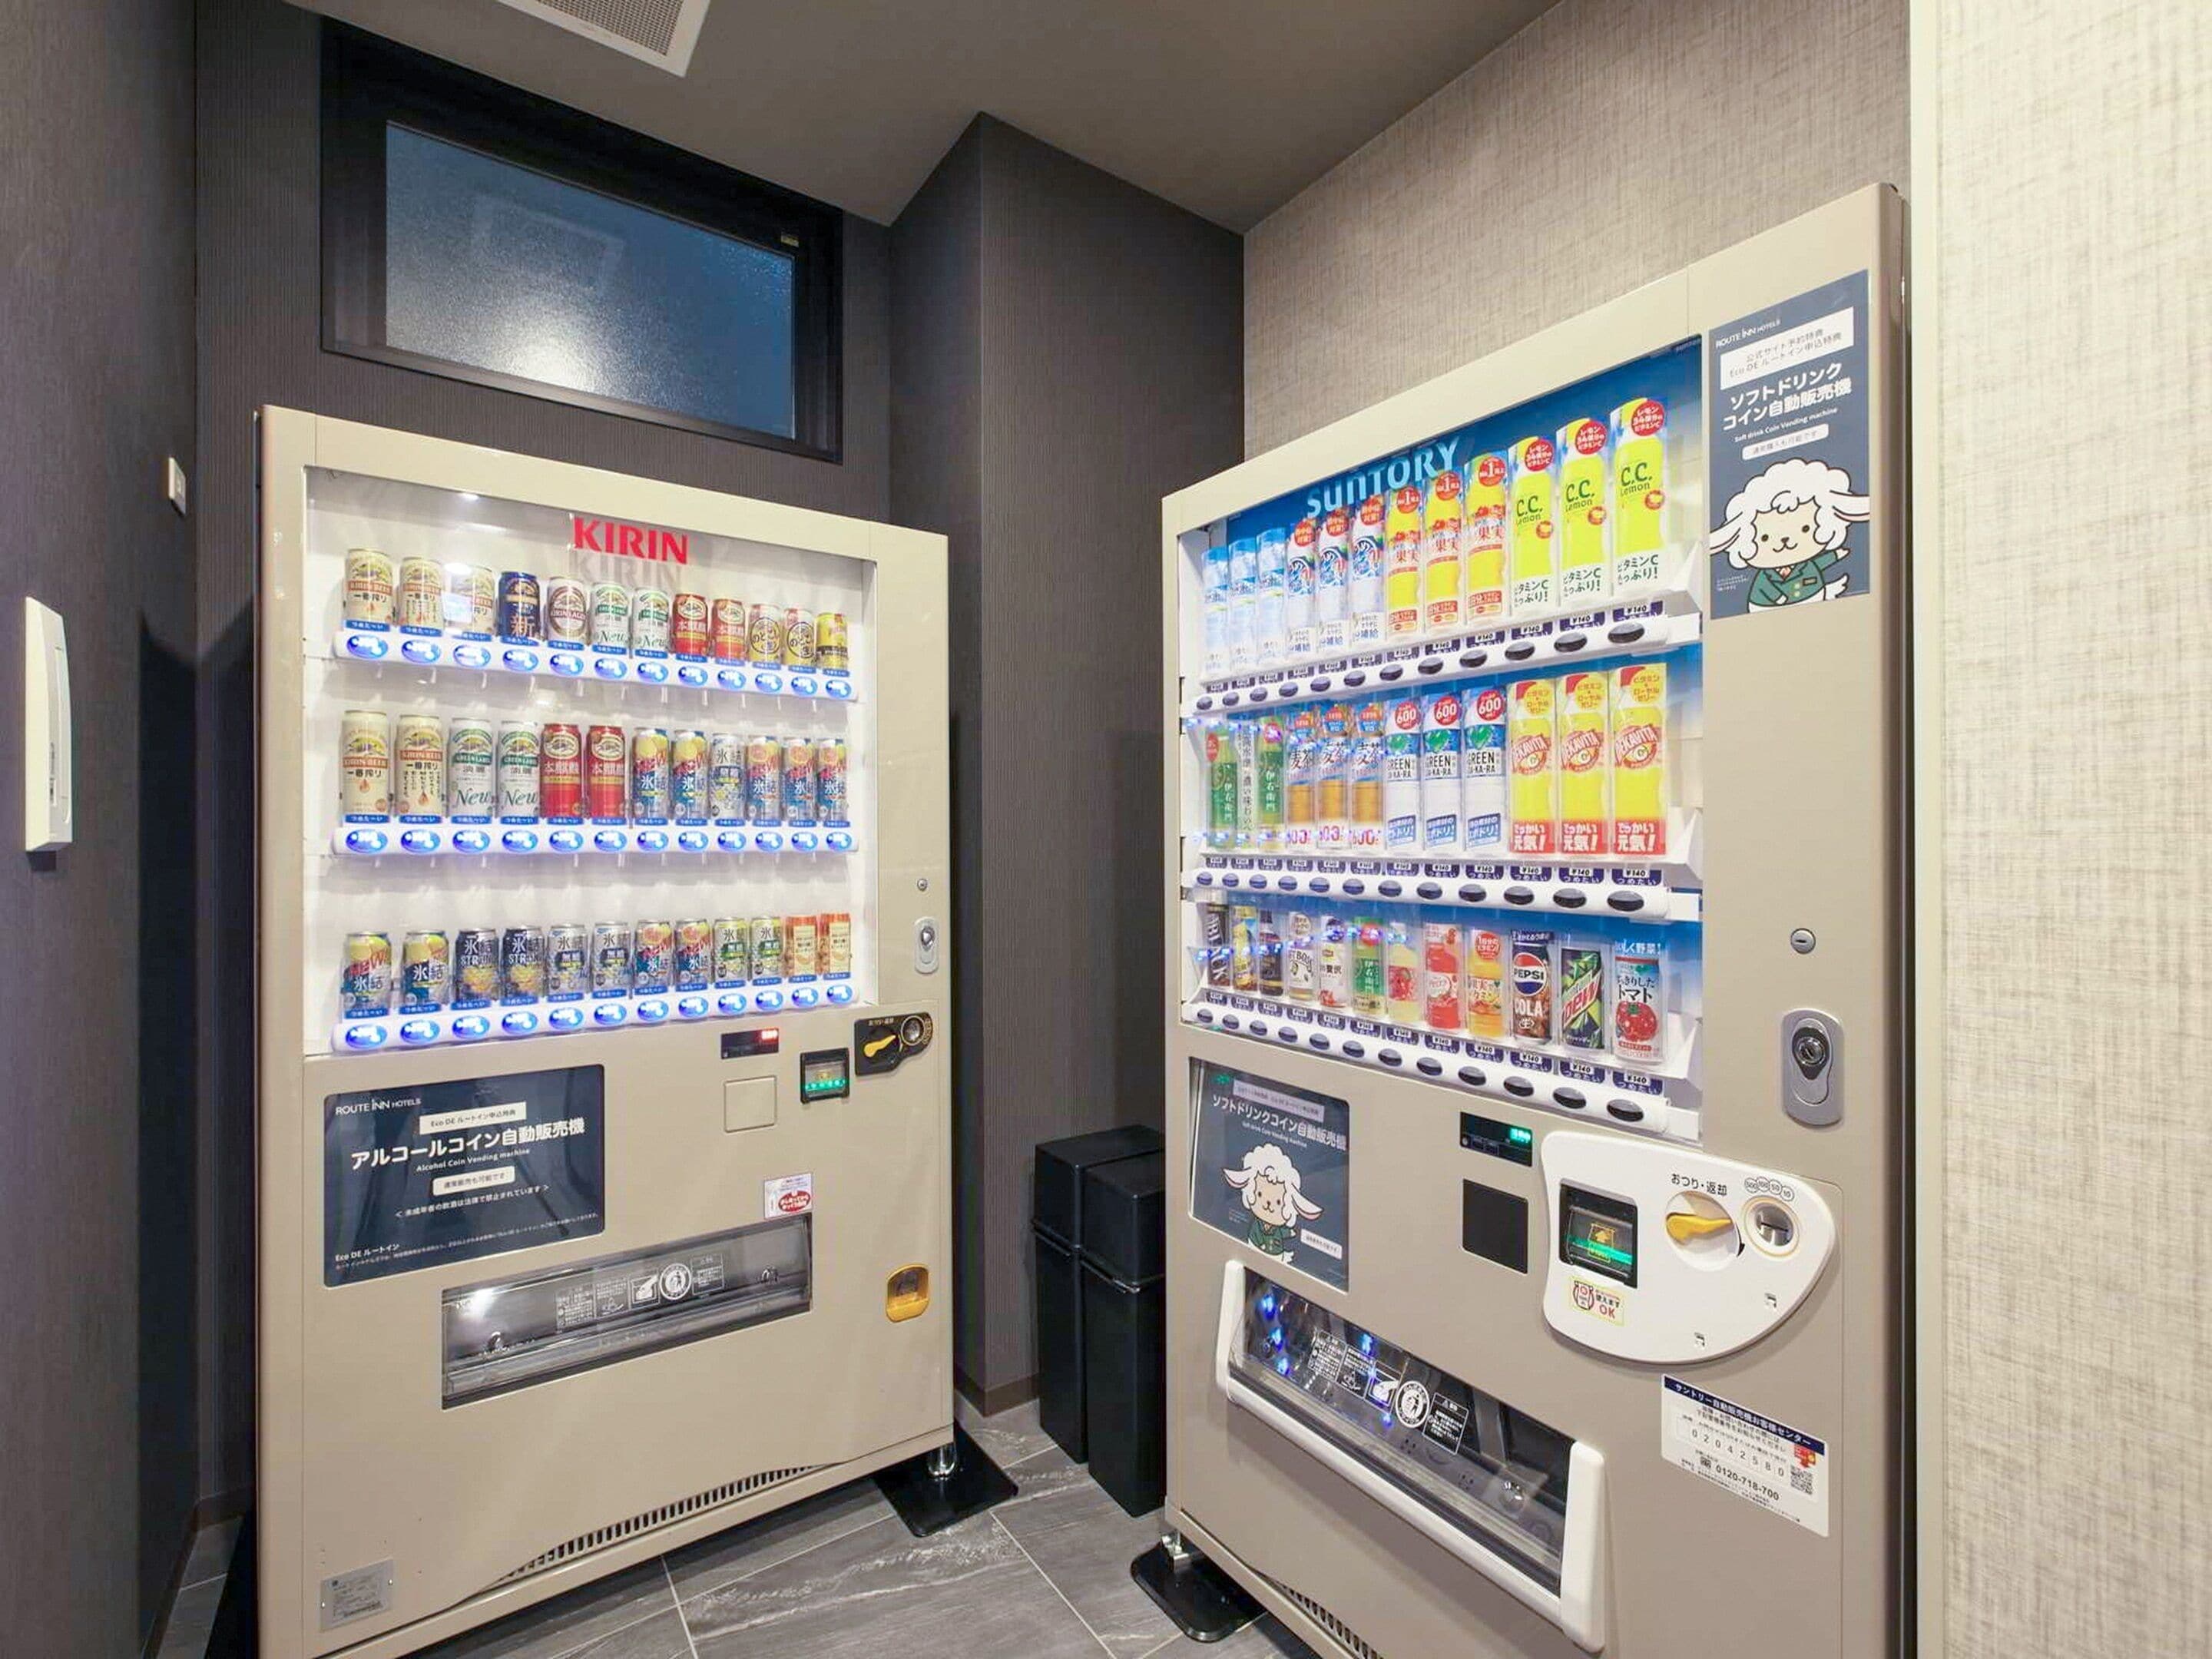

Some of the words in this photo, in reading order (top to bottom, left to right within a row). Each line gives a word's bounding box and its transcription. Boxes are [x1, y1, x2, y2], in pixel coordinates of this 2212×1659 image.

[1730, 363, 1842, 410] ソフトドリンク
[1723, 377, 1853, 431] コイン自動販売機
[1307, 439, 1459, 518] SUNTORY
[1621, 462, 1652, 487] C.C.
[1565, 479, 1595, 503] C.C.
[1516, 495, 1543, 518] C.C.
[573, 517, 688, 565] KIRIN
[353, 593, 387, 603] 一番搾り
[1627, 604, 1647, 614] ¥140
[1573, 614, 1591, 623] ¥140
[1435, 704, 1457, 720] 600
[1479, 697, 1502, 714] 600
[1396, 711, 1416, 724] 600
[347, 769, 382, 777] 一番搾り
[406, 761, 439, 770] 一番搾り
[1513, 834, 1546, 852] 元気!
[1563, 834, 1598, 852] 元気!
[1618, 834, 1657, 852] 元気!
[1522, 866, 1540, 874] ¥140
[1626, 869, 1646, 877] ¥140
[1562, 876, 1601, 884] つめたい
[1617, 877, 1657, 886] つめたい
[413, 958, 445, 981] 氷結
[1514, 968, 1545, 981] PEPSI
[1618, 984, 1653, 1003] トマト
[1515, 998, 1544, 1018] COLA
[1522, 1054, 1540, 1062] ¥140
[1564, 1069, 1601, 1083] つめたい
[1572, 1064, 1591, 1073] ¥140
[1616, 1081, 1657, 1094] つめたい
[1627, 1075, 1647, 1084] ¥140
[336, 1104, 370, 1115] ROUTE
[392, 1098, 422, 1108] HOTELS
[430, 1120, 444, 1128] Eco
[444, 1118, 456, 1126] DE
[1212, 1094, 1347, 1151] ソフトドリンクコイン自動販売機
[351, 1117, 586, 1171] アルコールコイン自動販売機
[416, 1161, 447, 1172] Alcohol
[467, 1153, 498, 1165] Vending
[499, 1147, 530, 1158] machine
[1671, 1173, 1728, 1197] おつり・返却
[1770, 1183, 1780, 1191] 50
[335, 1251, 350, 1261] Eco
[351, 1250, 362, 1259] DE
[363, 1243, 400, 1257] ルートイン
[1599, 1304, 1616, 1320] OK
[1674, 1382, 1812, 1446] サントリー自動販売機お客様センター
[1716, 1464, 1780, 1501] 0120-718-700
